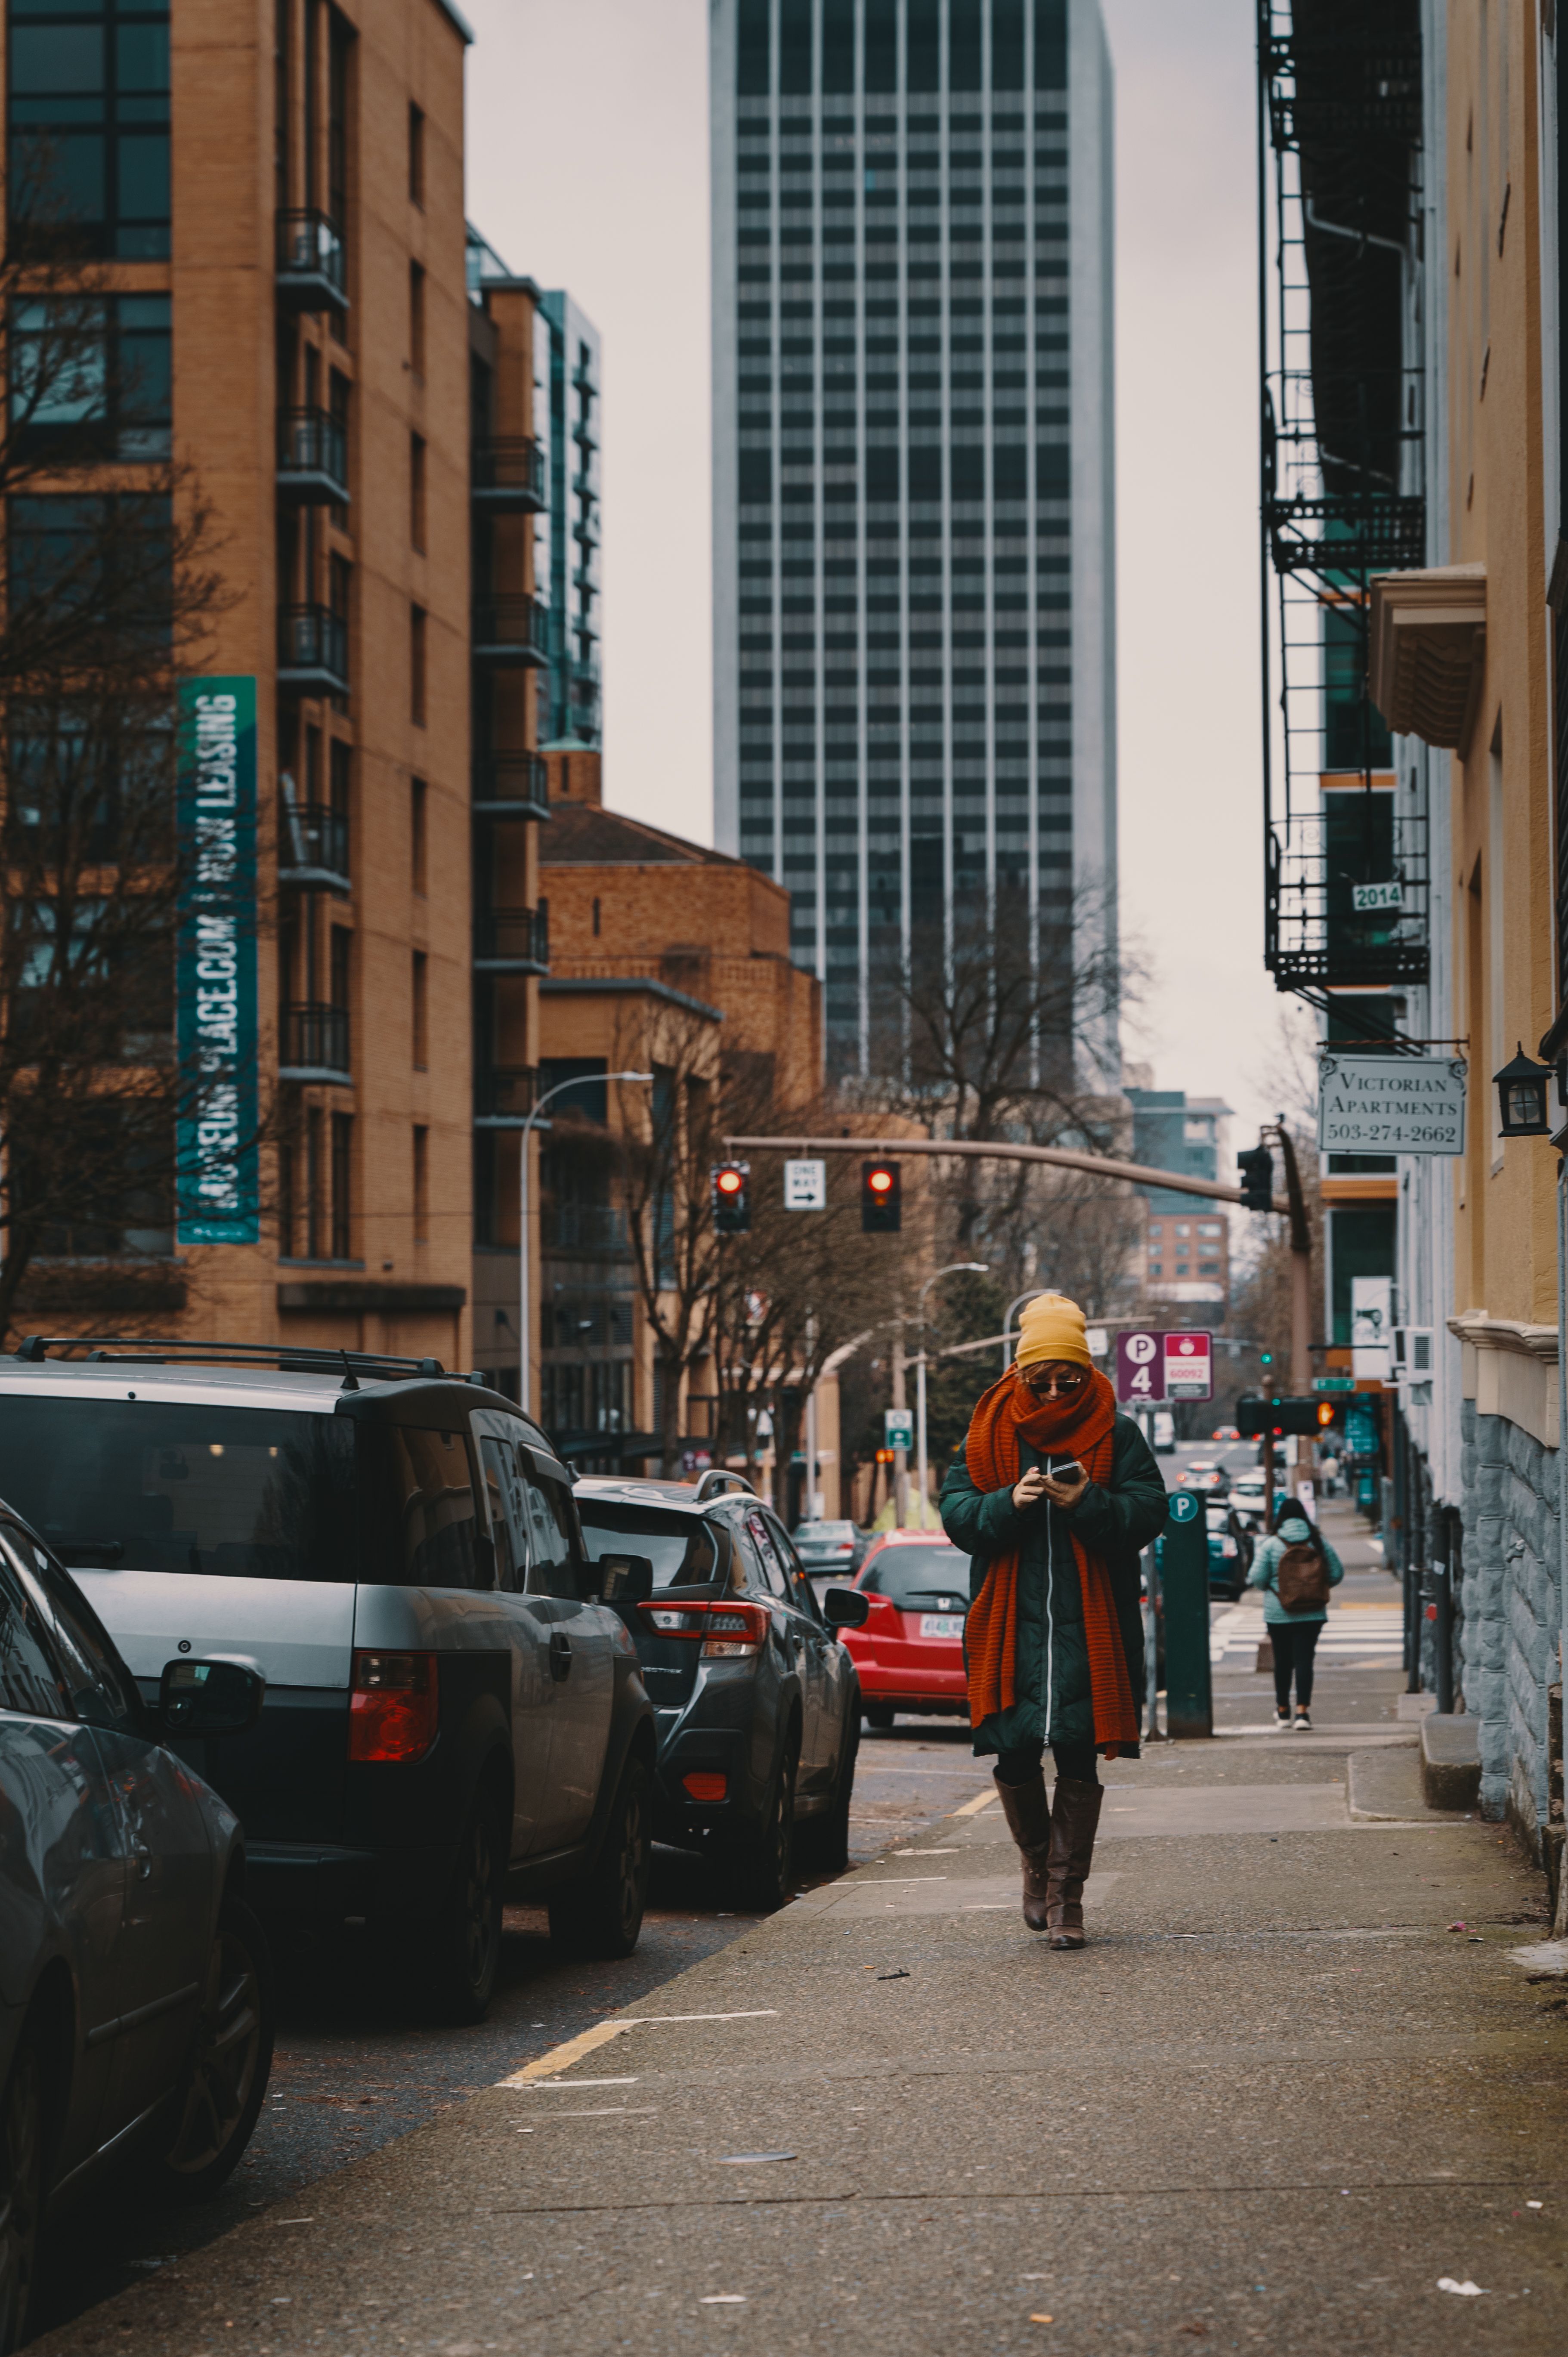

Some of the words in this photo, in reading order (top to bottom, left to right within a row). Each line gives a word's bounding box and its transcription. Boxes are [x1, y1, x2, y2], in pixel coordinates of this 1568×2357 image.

[196, 695, 236, 807] LEASING
[195, 817, 236, 882] NOW
[1357, 887, 1399, 906] 2014
[1339, 1073, 1447, 1092] VICTORIAN
[1329, 1096, 1457, 1116] APARTMENTS
[1328, 1124, 1456, 1143] 503-274-2662
[793, 1166, 816, 1175] ONE
[793, 1179, 817, 1187] WAY
[1136, 1340, 1148, 1358] P
[1131, 1366, 1152, 1392] 4
[1177, 1497, 1190, 1516] P
